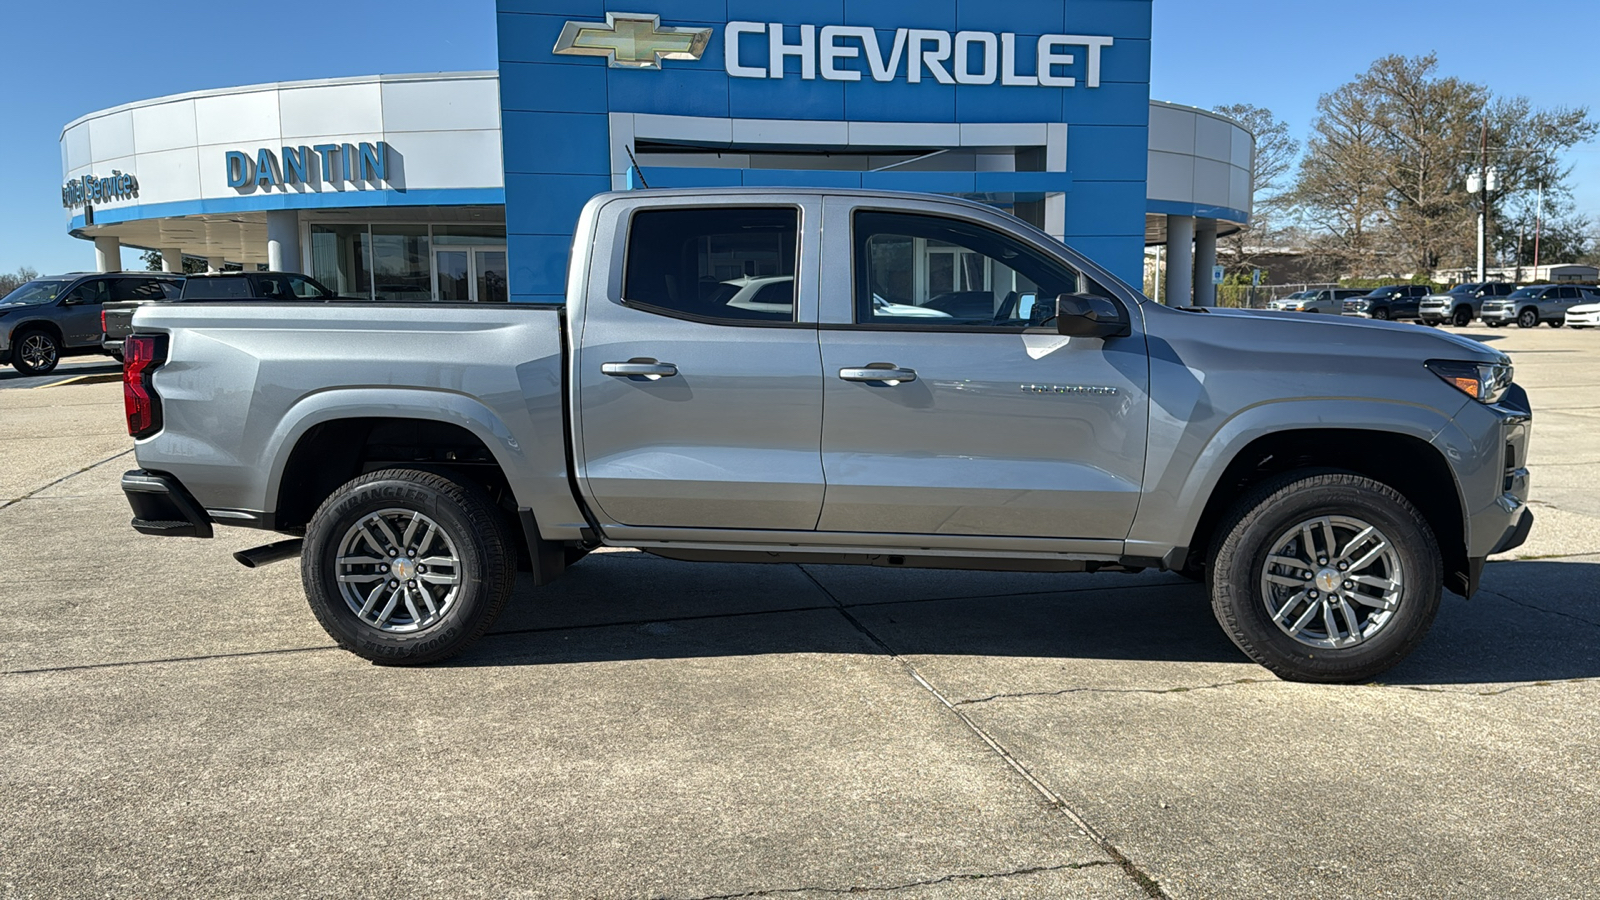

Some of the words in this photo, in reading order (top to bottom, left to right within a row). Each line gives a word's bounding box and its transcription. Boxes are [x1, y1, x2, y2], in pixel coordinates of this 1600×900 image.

[725, 20, 1114, 88] CHEVROLET
[225, 141, 387, 188] DANTIN
[85, 172, 134, 201] Service
[334, 486, 429, 516] WRANGLER
